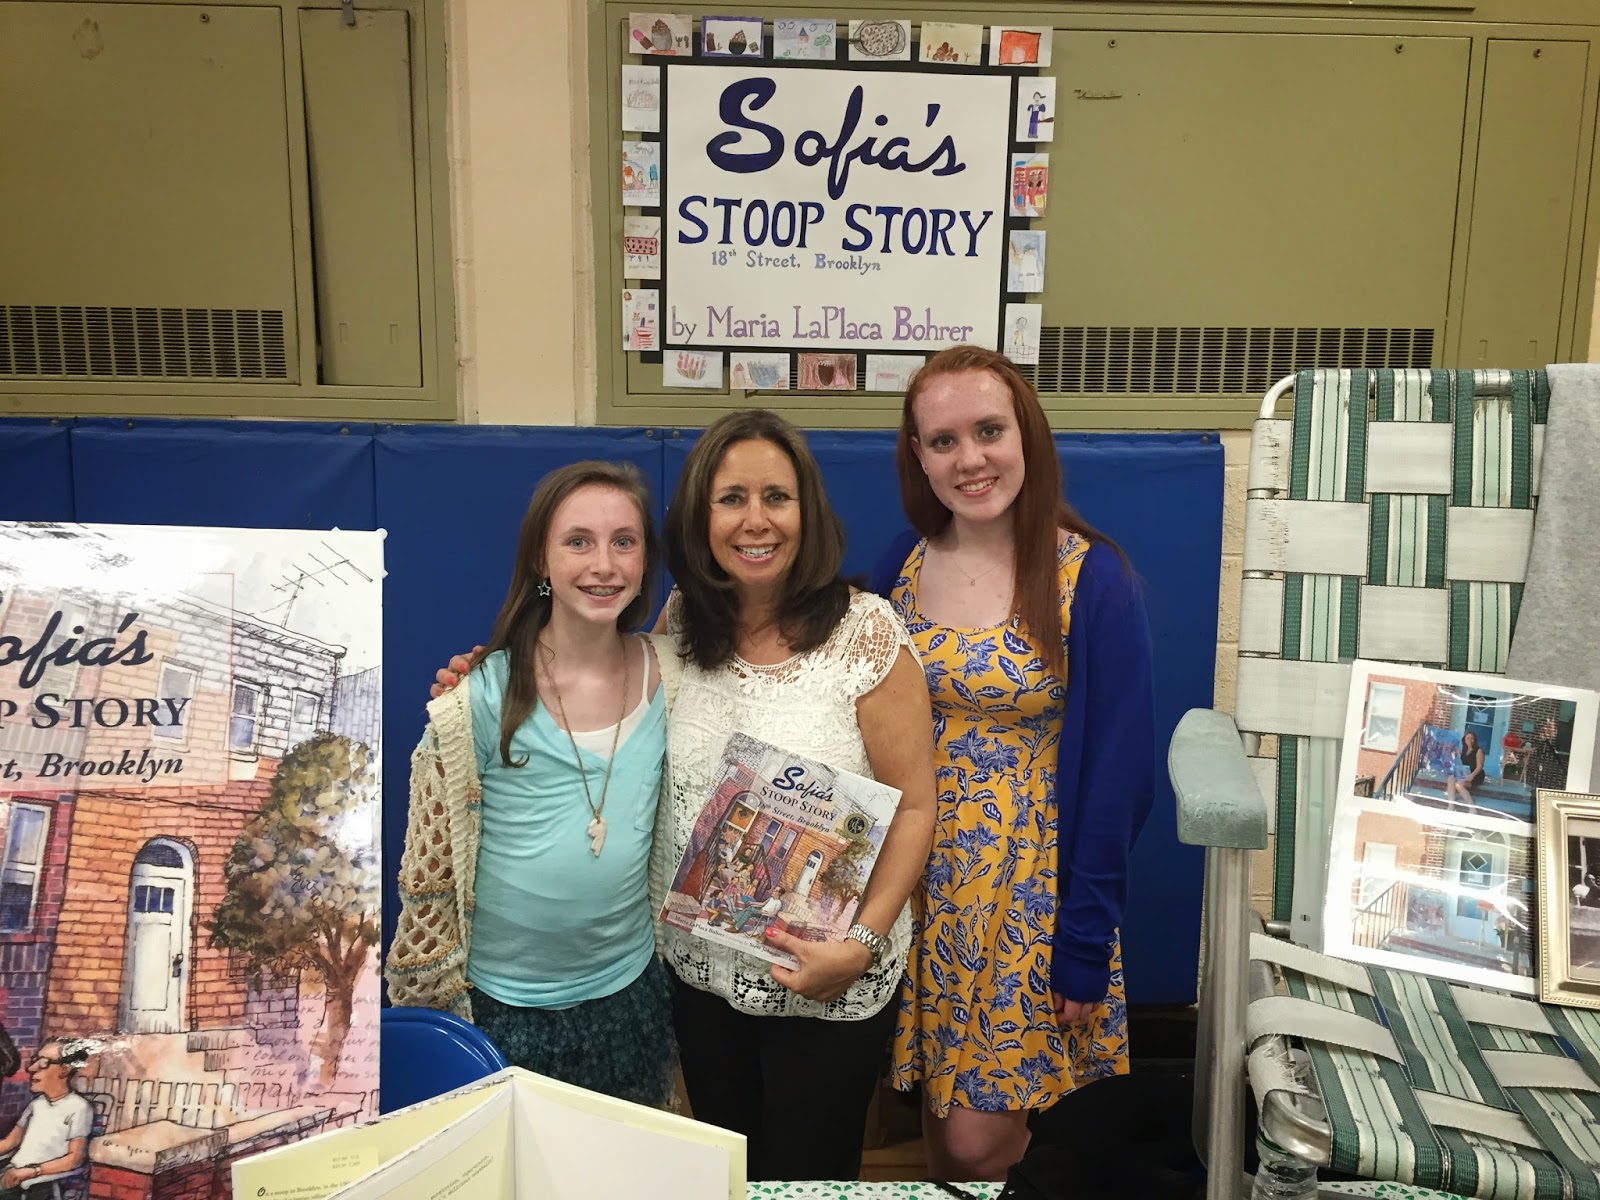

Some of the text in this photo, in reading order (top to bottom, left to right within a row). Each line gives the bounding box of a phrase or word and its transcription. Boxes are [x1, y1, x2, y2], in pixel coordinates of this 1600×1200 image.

[706, 77, 966, 200] Sofia's
[678, 195, 993, 257] STOOP STORY
[711, 250, 882, 275] 18th Street, Brooklyn
[671, 305, 974, 344] by Maria LaPlaca Bohrer
[32, 692, 192, 730] STORY
[36, 749, 184, 784] Brooklyn
[771, 766, 834, 802] Sofia's
[760, 786, 837, 822] STOOP STORY
[772, 806, 795, 821] Street,
[797, 815, 830, 833] Brooklyn
